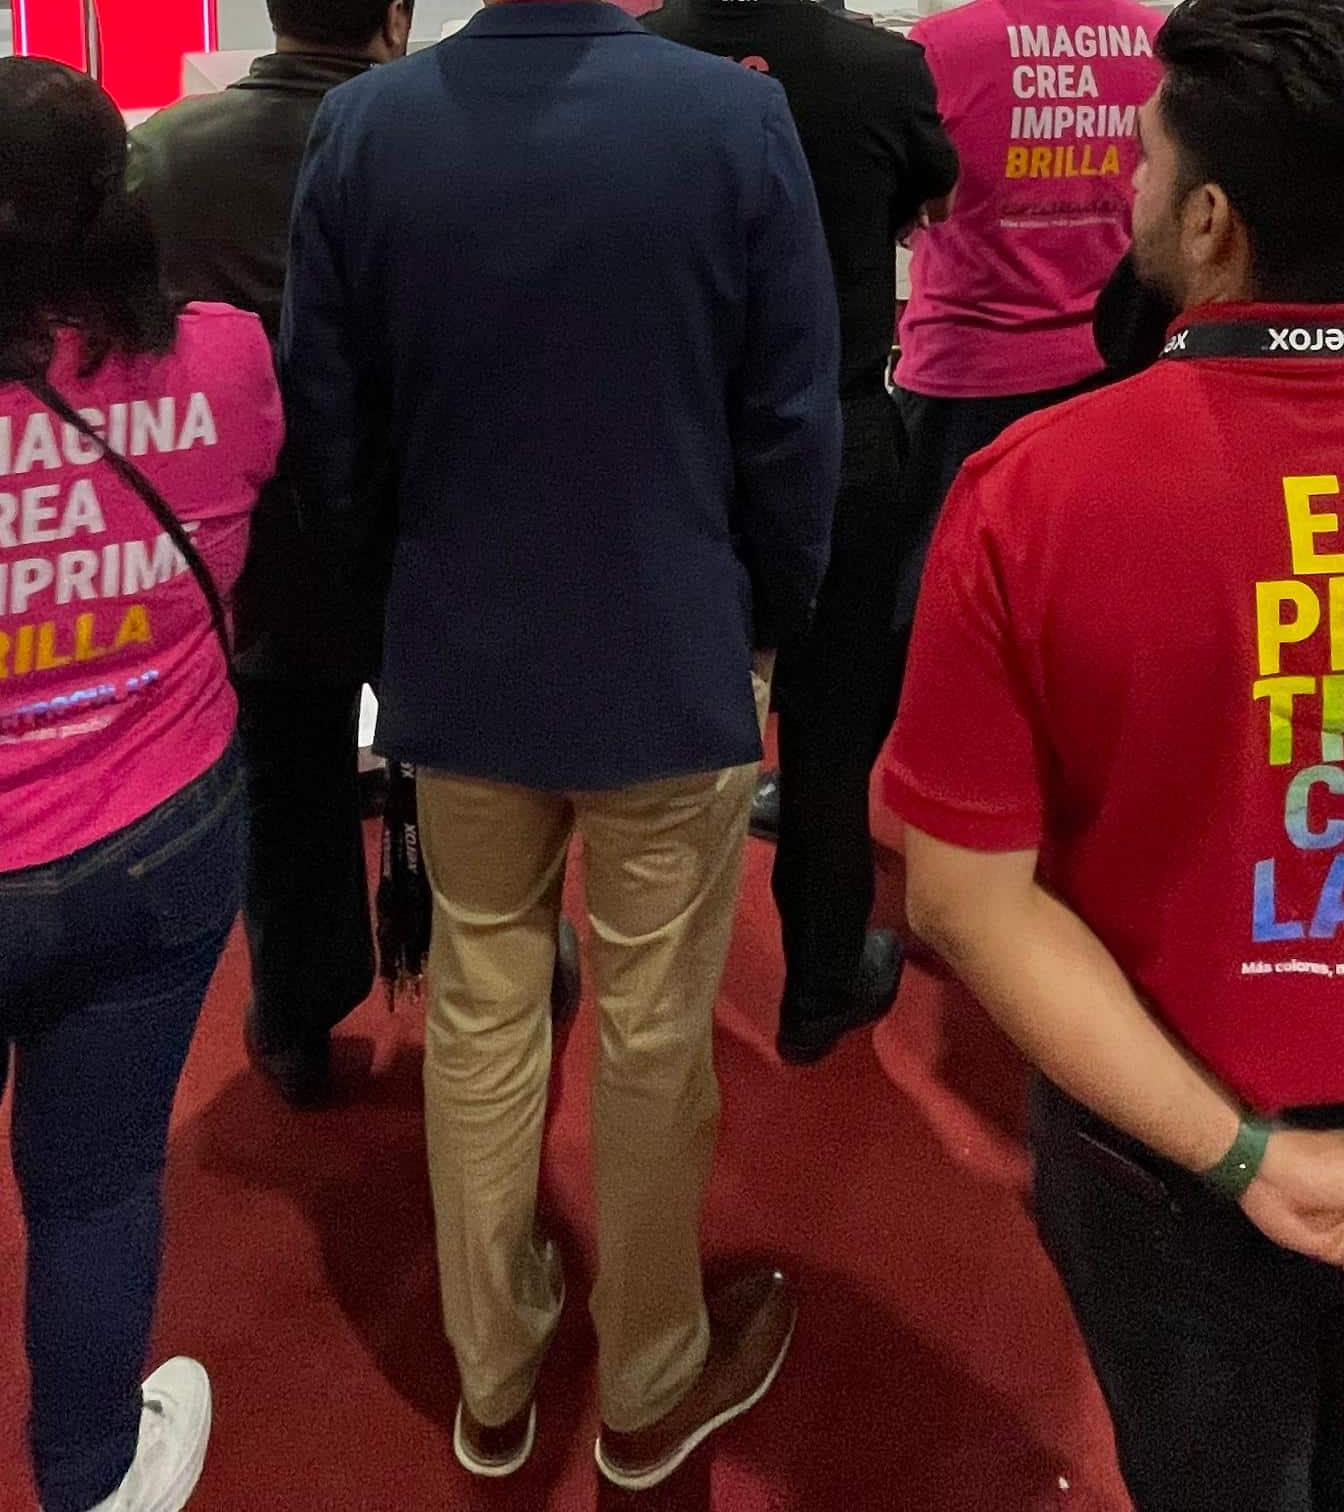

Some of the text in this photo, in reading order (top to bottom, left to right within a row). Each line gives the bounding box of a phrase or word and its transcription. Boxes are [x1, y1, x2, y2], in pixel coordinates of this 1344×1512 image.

[1007, 25, 1154, 59] IMAGINA
[1012, 64, 1099, 100] CREA
[1010, 104, 1140, 139] IMPRIM
[1005, 144, 1121, 179] BRILLA
[1274, 959, 1333, 977] colores,
